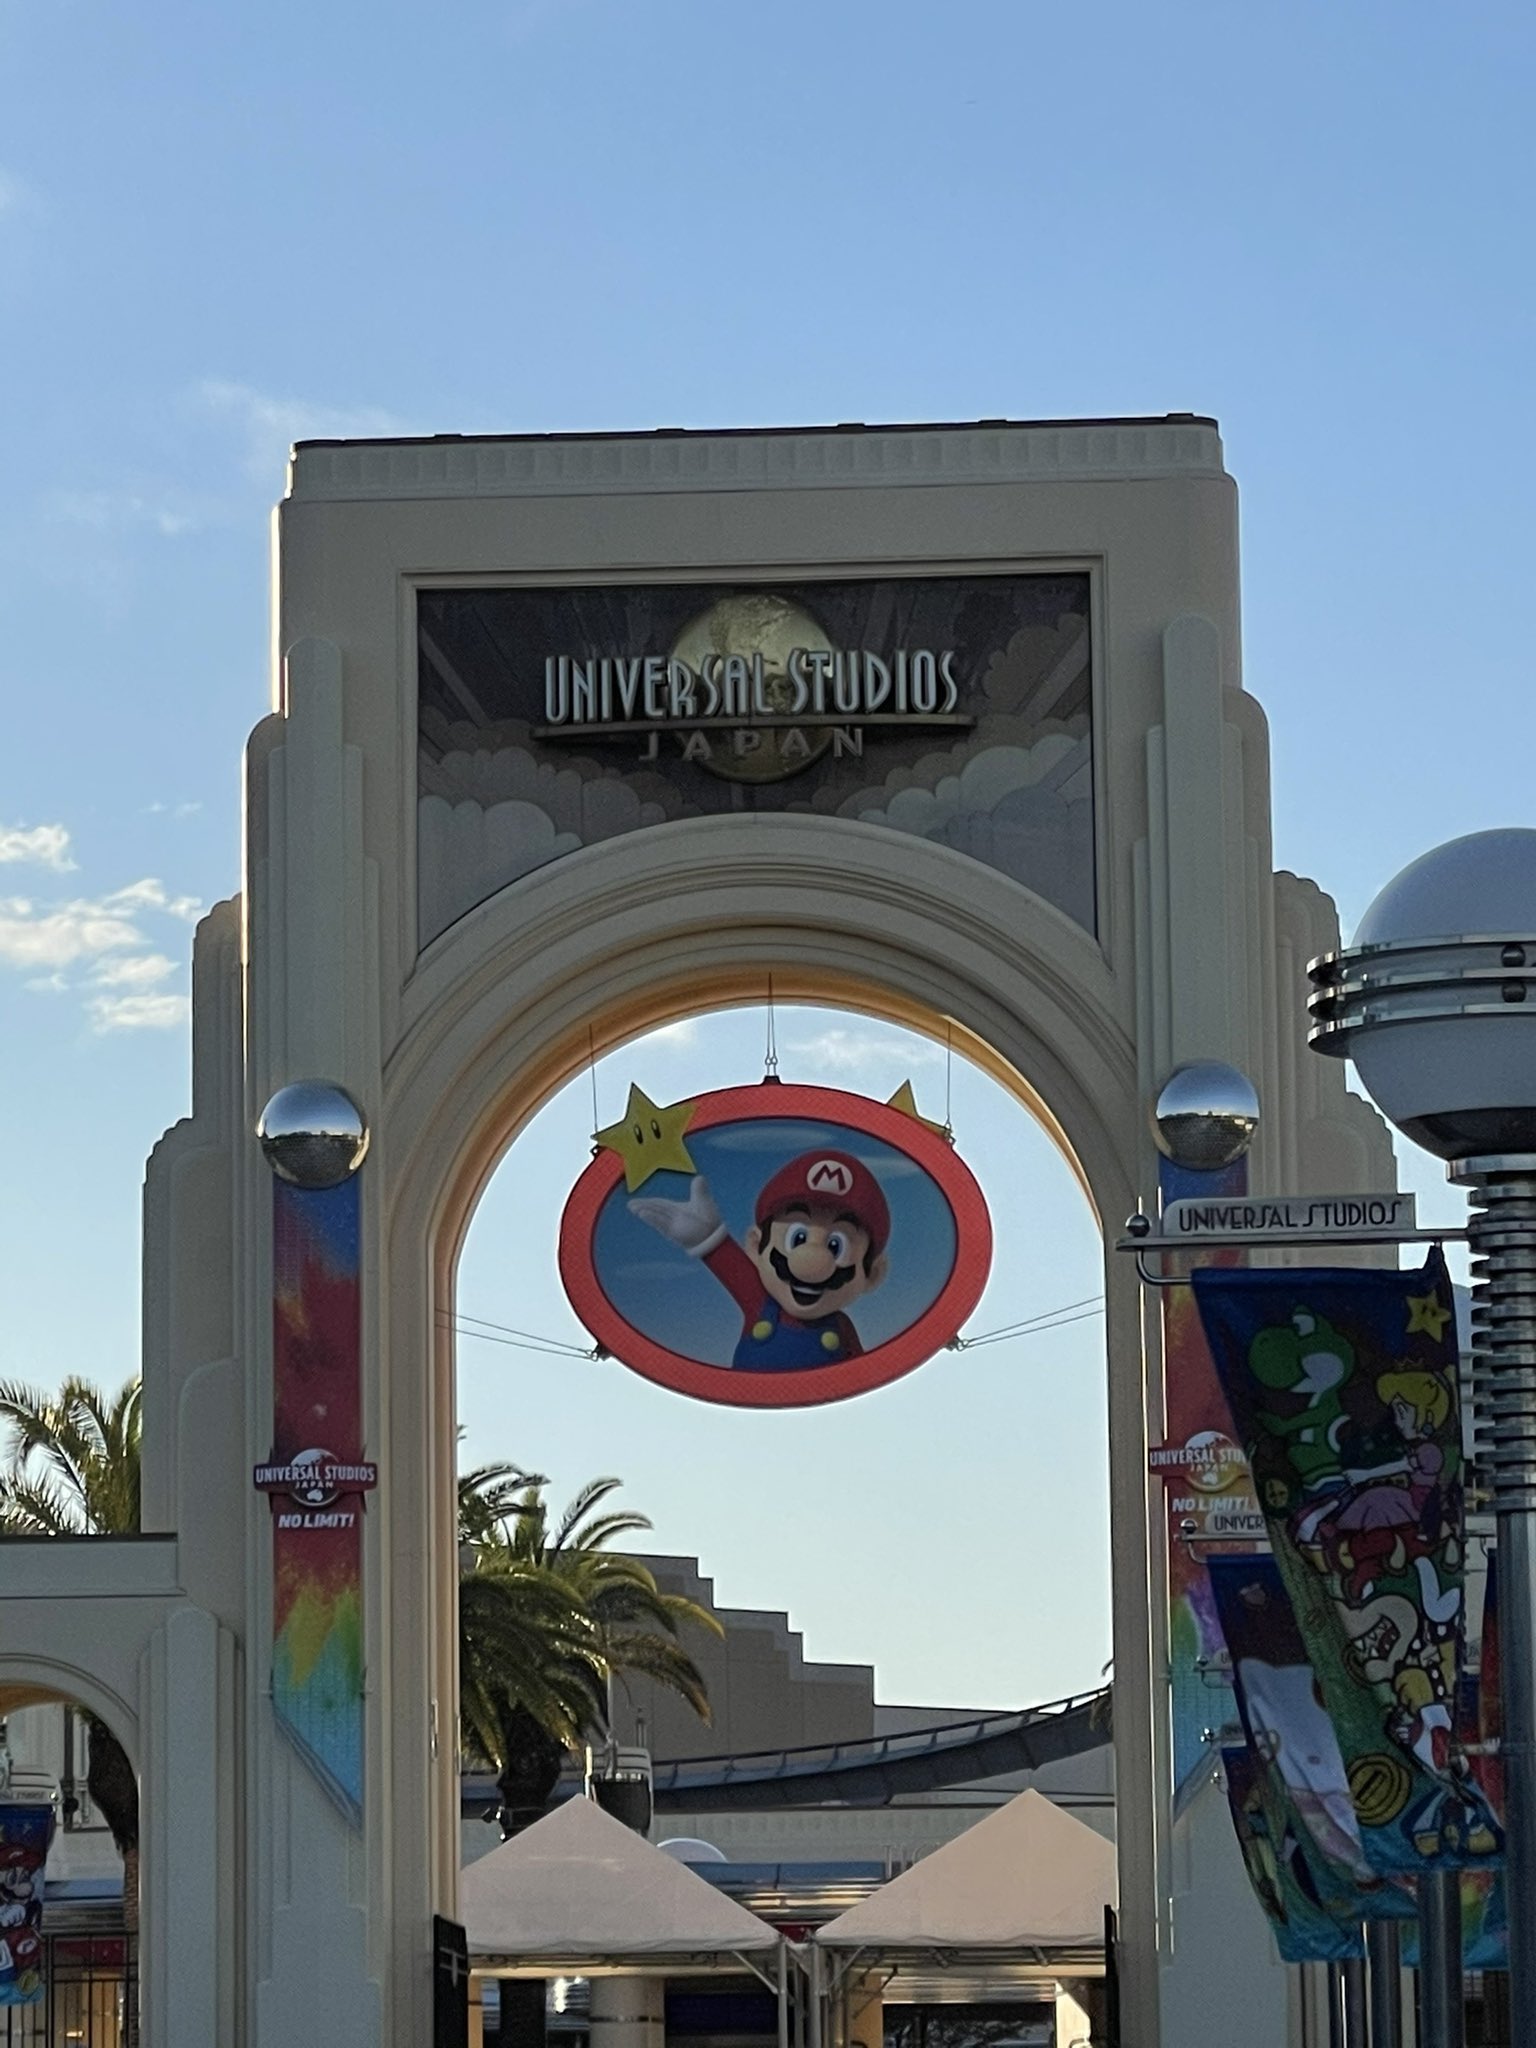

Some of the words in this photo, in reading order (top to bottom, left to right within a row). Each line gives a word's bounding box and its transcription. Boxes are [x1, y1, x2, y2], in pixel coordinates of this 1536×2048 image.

[545, 651, 775, 724] UNIVERSAL
[787, 647, 959, 716] STUDIOS
[638, 727, 863, 762] JAPAN
[811, 1163, 846, 1192] M
[1179, 1205, 1299, 1231] UNIVERSAL
[1302, 1202, 1402, 1229] STUDIOS
[1150, 1449, 1216, 1466] UNIVERSAL
[1220, 1448, 1247, 1464] STU
[255, 1466, 320, 1483] UNIVERSAL
[325, 1465, 375, 1482] STUDIOS
[295, 1481, 334, 1489] JAPAN
[1172, 1498, 1195, 1512] NO
[278, 1514, 302, 1528] NO
[303, 1513, 355, 1528] LIMIT!
[1213, 1514, 1265, 1532] UNIVER
